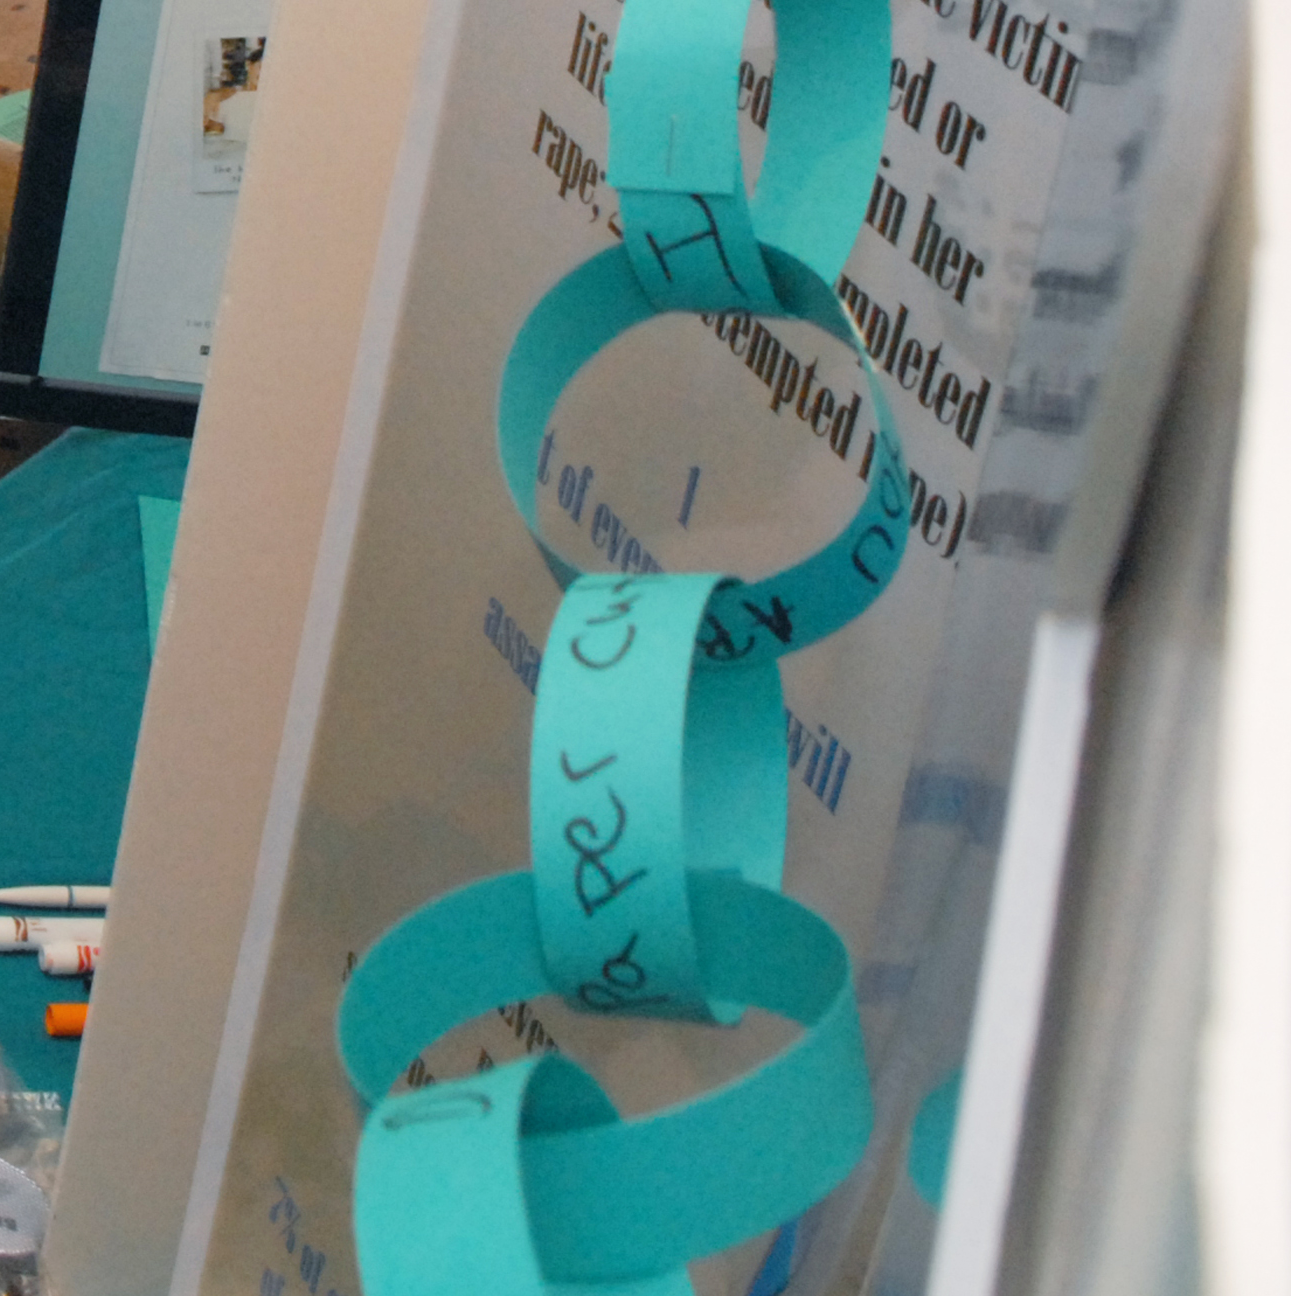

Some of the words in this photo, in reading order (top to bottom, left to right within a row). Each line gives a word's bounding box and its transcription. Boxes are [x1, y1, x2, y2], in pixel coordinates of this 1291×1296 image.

[935, 100, 988, 171] or
[863, 155, 909, 248] in
[910, 192, 986, 307] her
[784, 706, 851, 817] will
